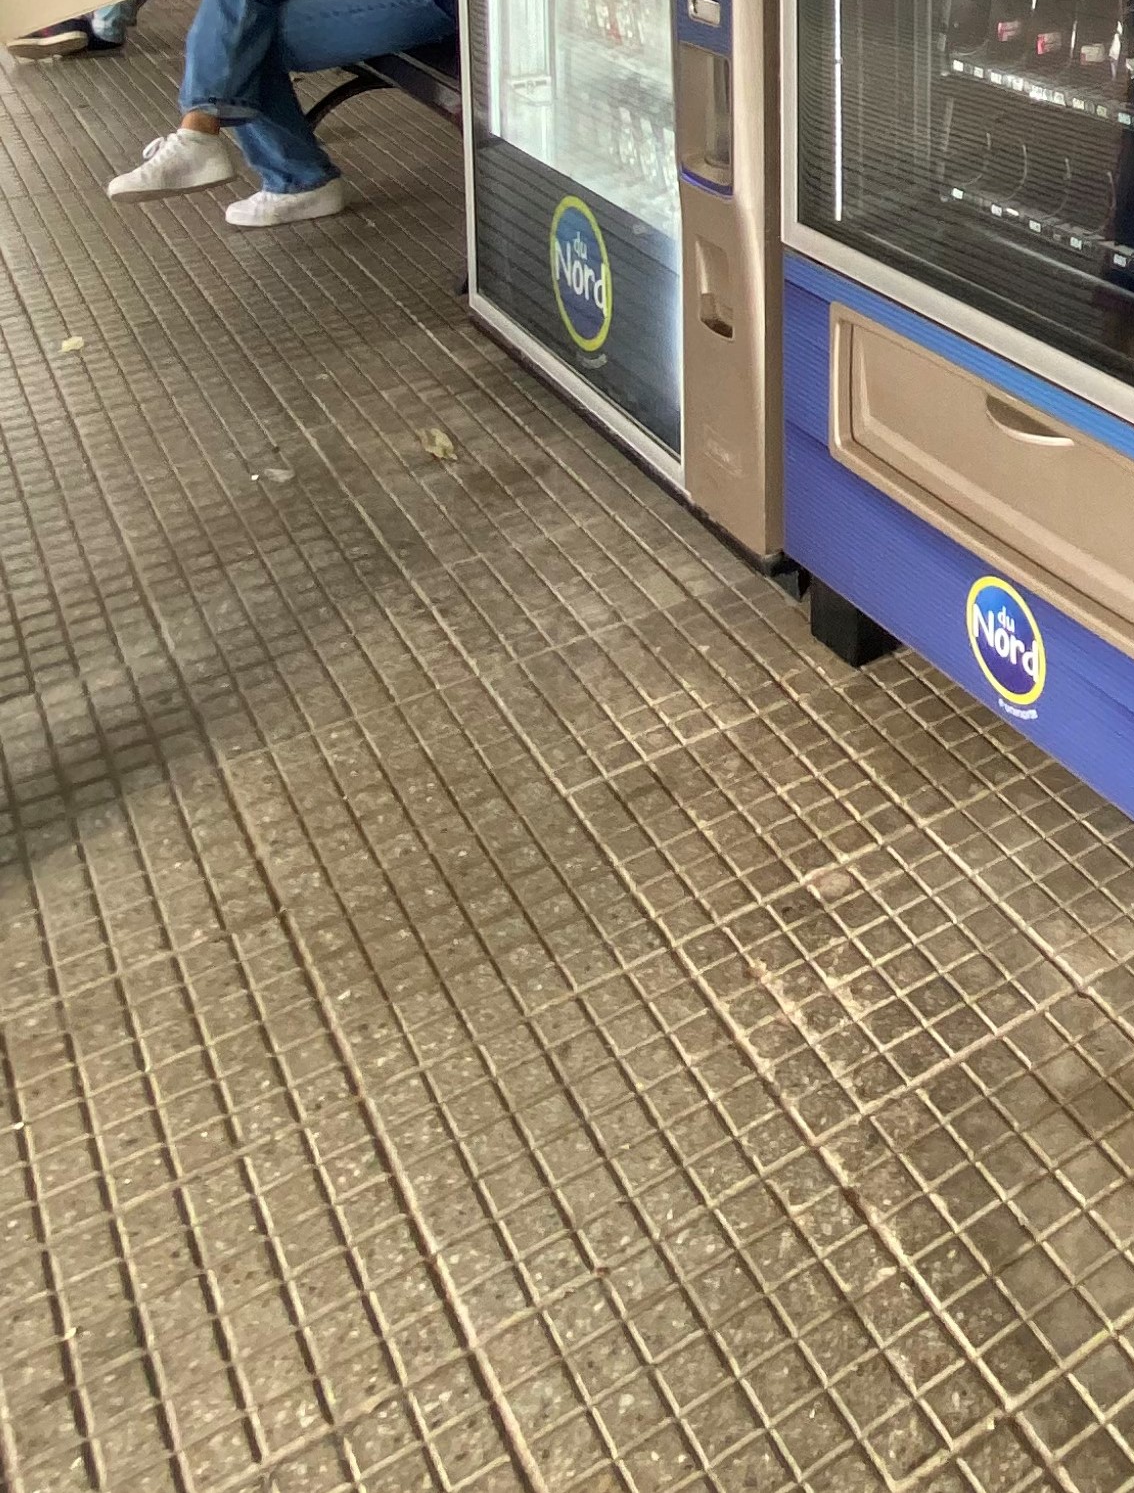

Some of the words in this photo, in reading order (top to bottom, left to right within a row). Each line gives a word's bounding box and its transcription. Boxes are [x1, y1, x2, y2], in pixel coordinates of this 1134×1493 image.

[574, 231, 588, 260] du
[555, 237, 608, 319] Nord
[973, 603, 1040, 683] Nord
[998, 606, 1016, 633] du
